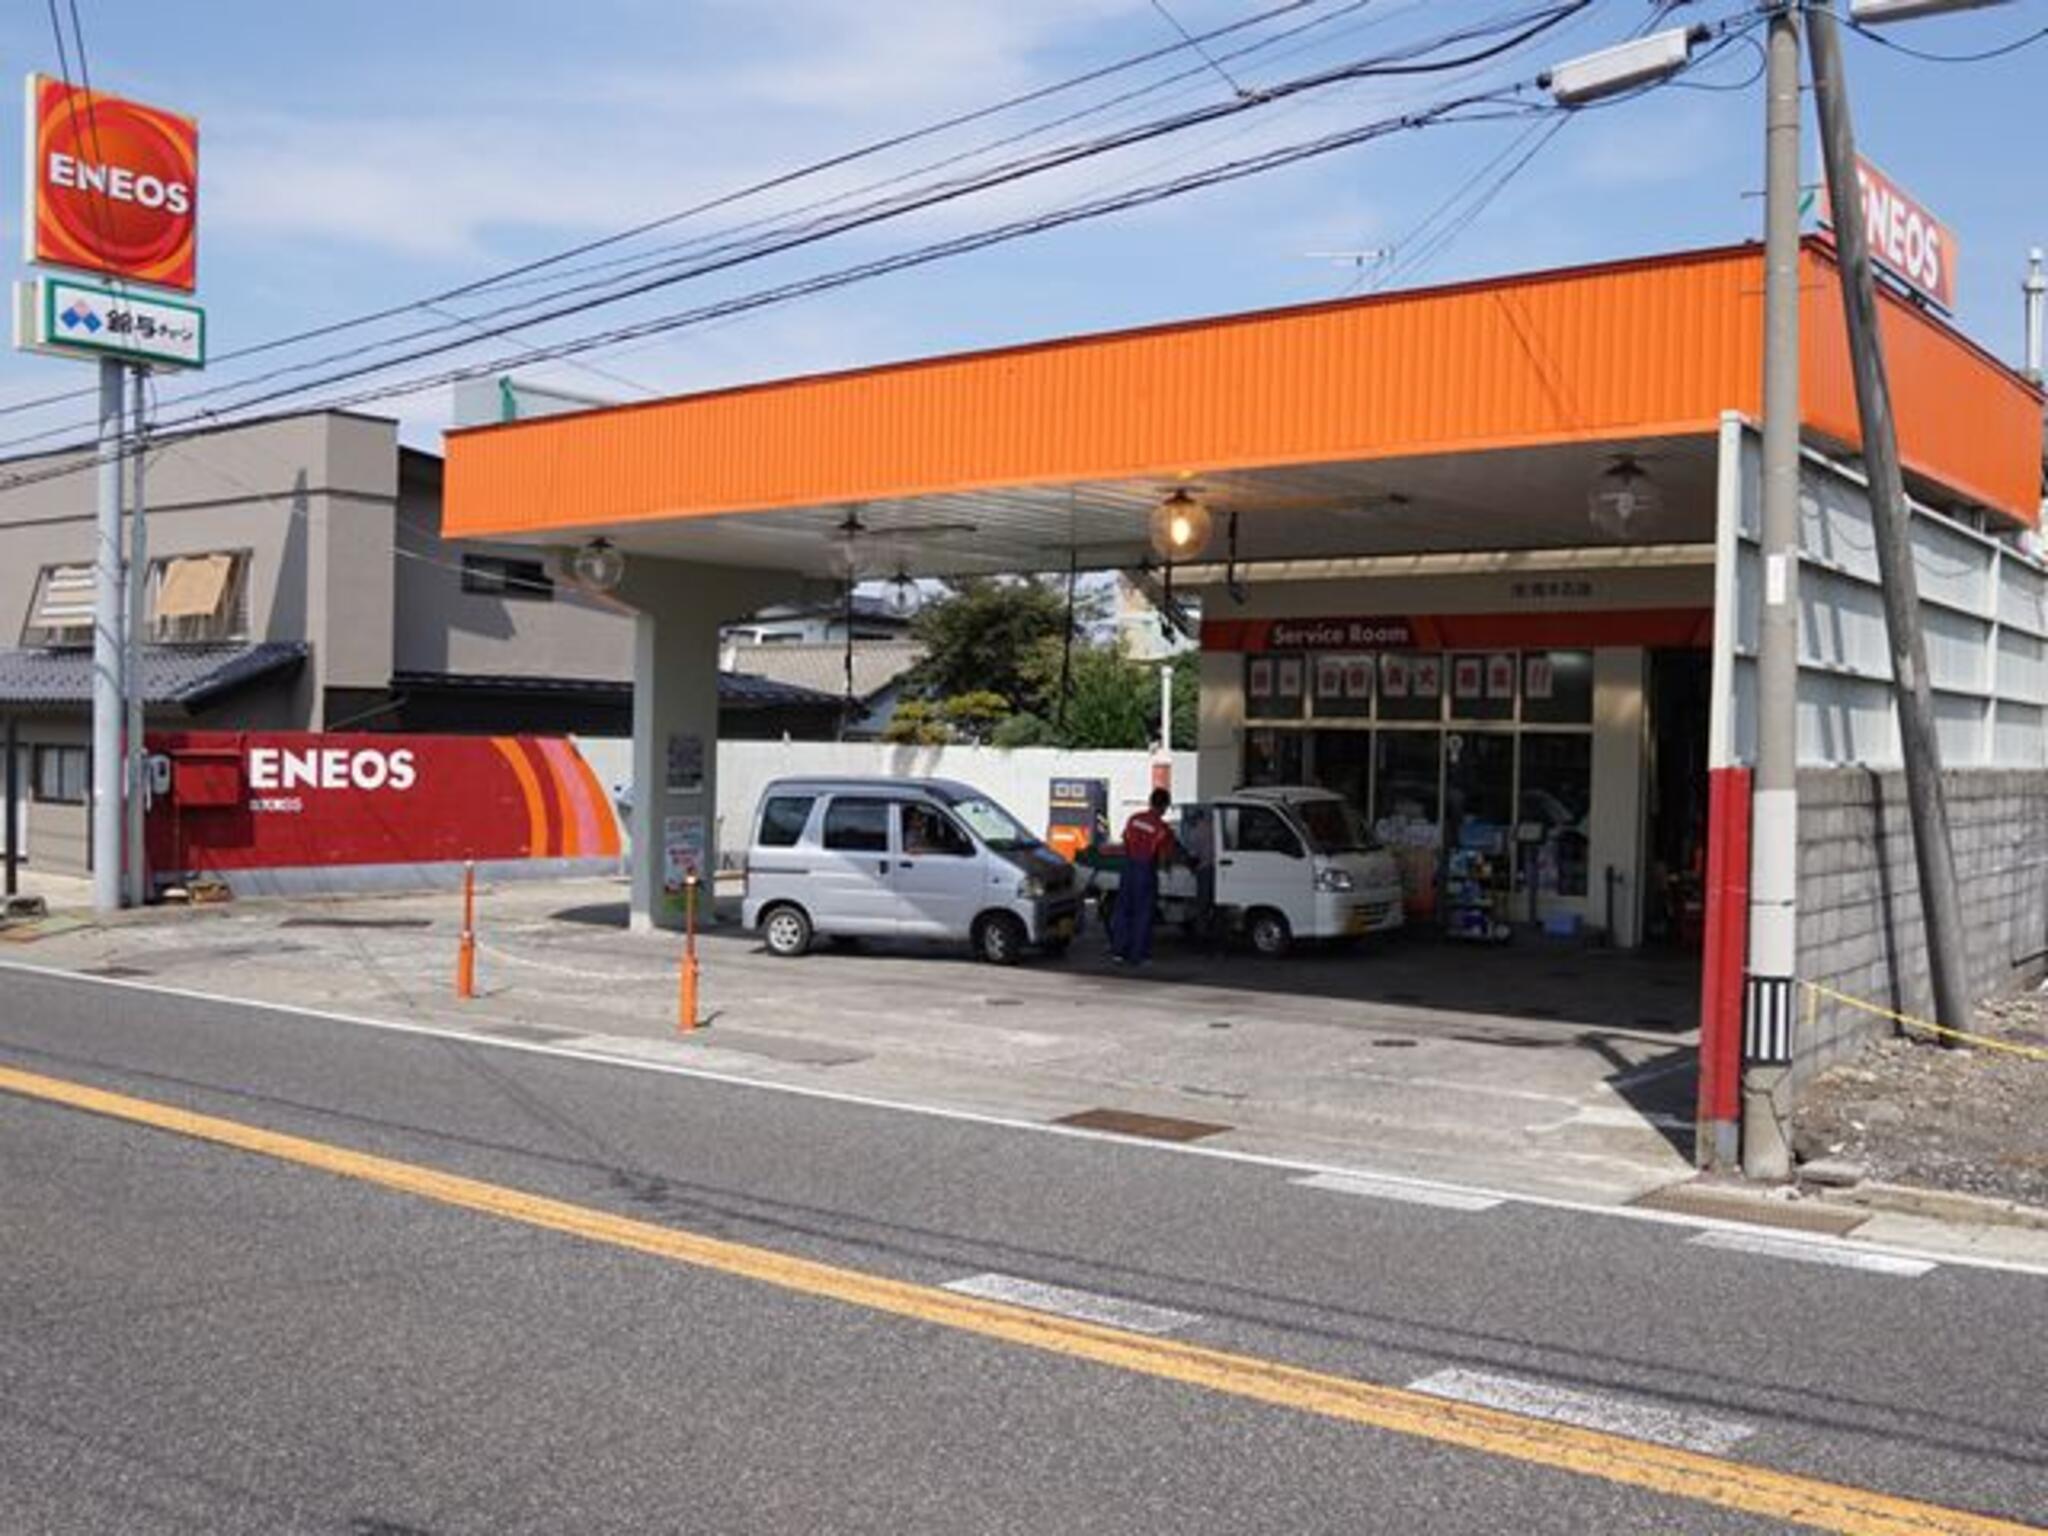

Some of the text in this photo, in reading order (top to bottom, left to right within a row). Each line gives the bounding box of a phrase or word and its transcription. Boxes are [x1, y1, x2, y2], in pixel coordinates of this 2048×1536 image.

[49, 151, 189, 214] ENEOS
[1858, 169, 1938, 289] NEOS
[1273, 622, 1409, 645] Service Room
[250, 749, 416, 790] ENEOS
